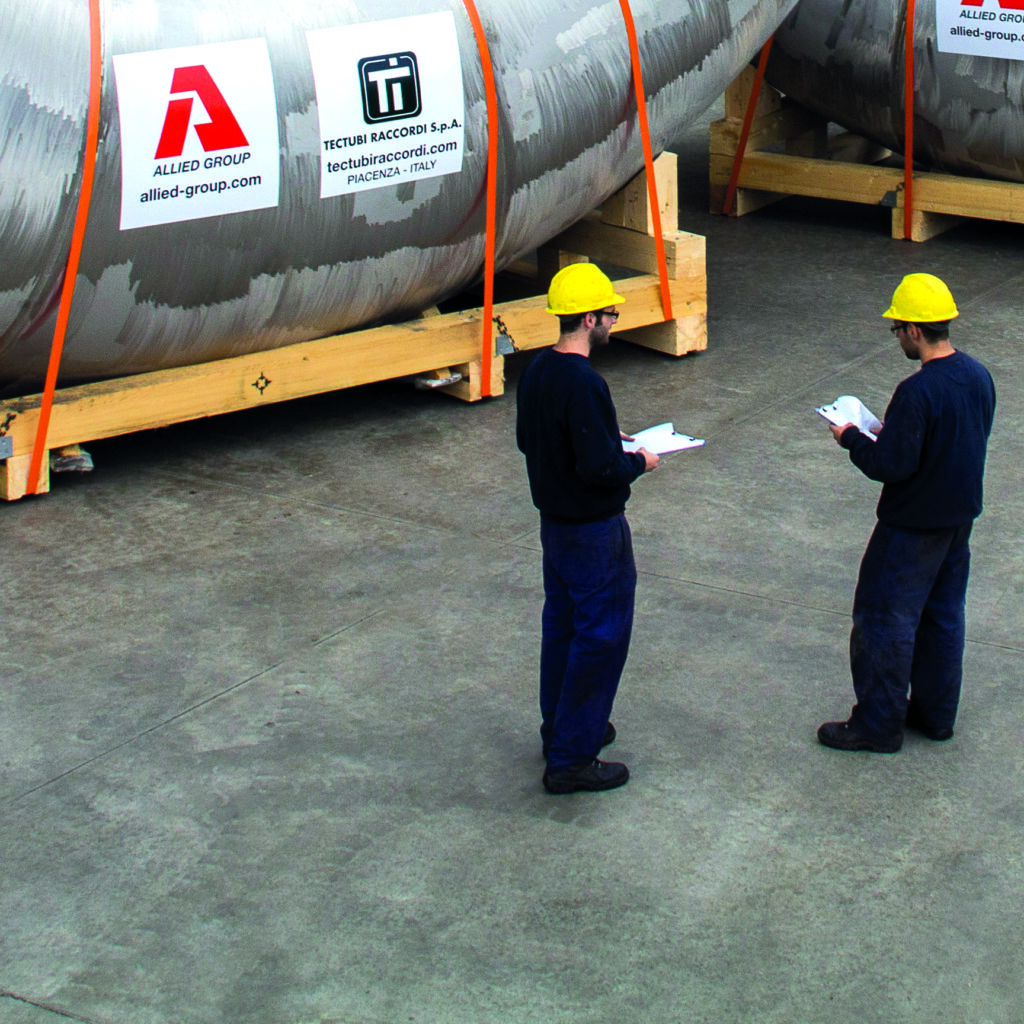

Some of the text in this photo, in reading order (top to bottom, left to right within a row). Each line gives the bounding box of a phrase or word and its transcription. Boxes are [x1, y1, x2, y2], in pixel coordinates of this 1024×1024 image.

[959, 9, 996, 22] ALLIED
[323, 118, 462, 151] TECTUBI RACCORDI S.p.A.
[153, 152, 251, 177] ALLIED GROUP
[327, 140, 458, 174] tectubiraccordi.com
[347, 167, 401, 185] PIACENZA
[409, 160, 437, 175] ITALY
[140, 174, 262, 203] allied-group.com
